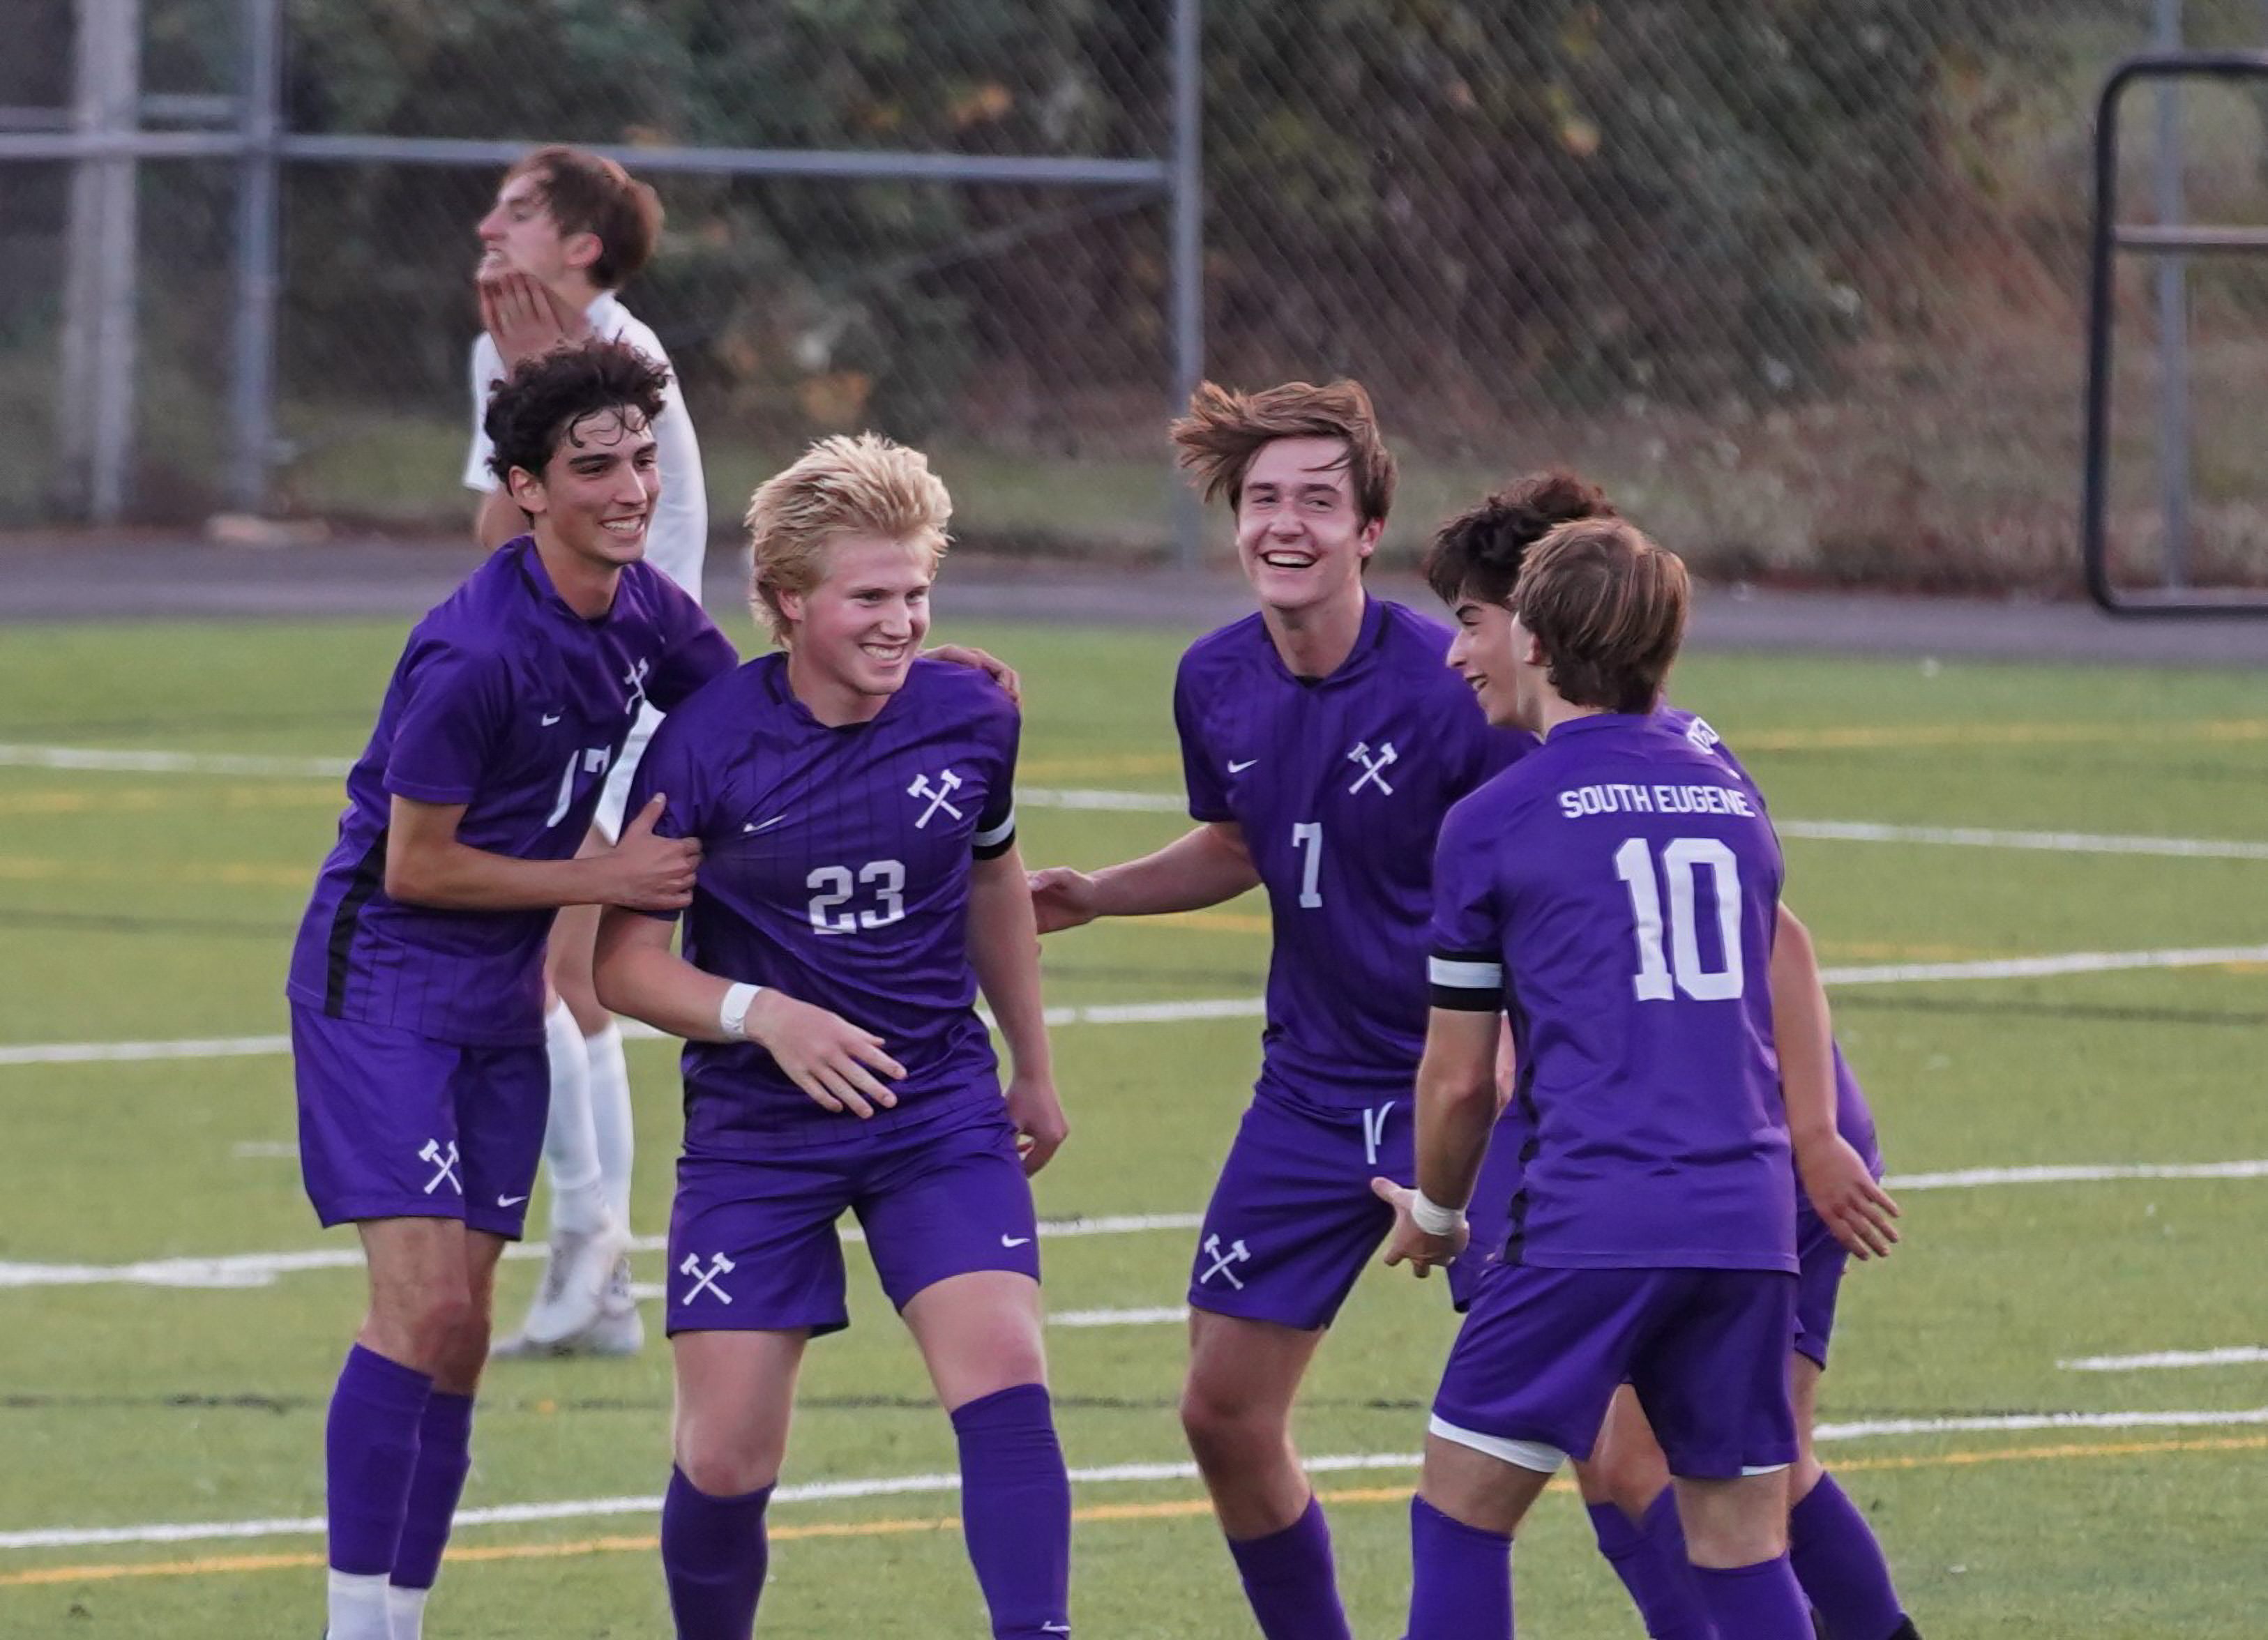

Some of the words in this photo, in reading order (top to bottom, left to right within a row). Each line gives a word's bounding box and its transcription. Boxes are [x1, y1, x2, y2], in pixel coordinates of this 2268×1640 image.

[1560, 784, 1654, 818] SOUTH
[1654, 785, 1756, 817] EUGENE
[806, 859, 906, 935] 23
[1293, 822, 1322, 908] 7
[1613, 837, 1744, 1001] 10
